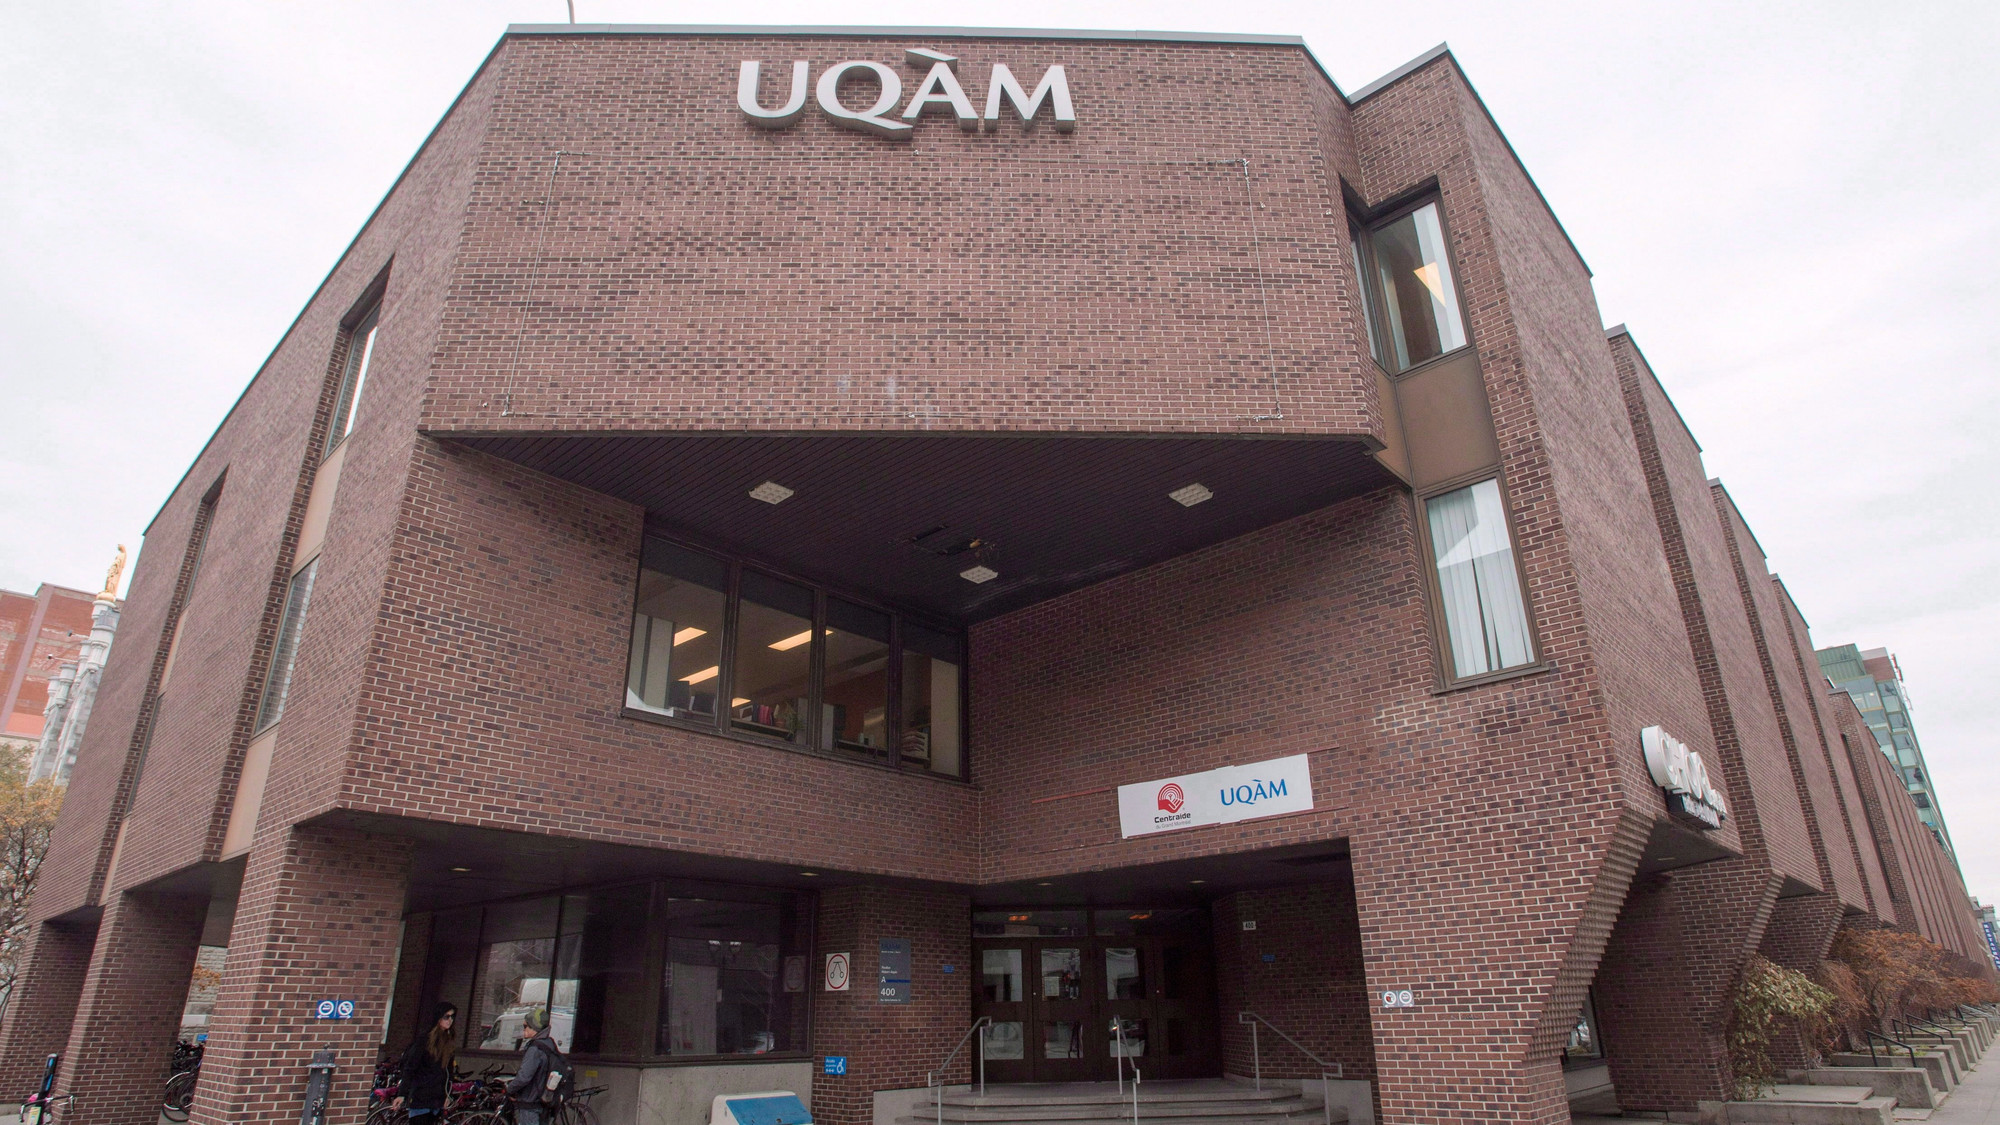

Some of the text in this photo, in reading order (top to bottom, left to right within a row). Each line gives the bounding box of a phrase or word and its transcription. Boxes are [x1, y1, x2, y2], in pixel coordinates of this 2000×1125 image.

[737, 47, 1075, 138] UQÀM
[1220, 778, 1288, 806] UQÀM
[1154, 812, 1191, 823] Centraide
[880, 988, 896, 996] 400
